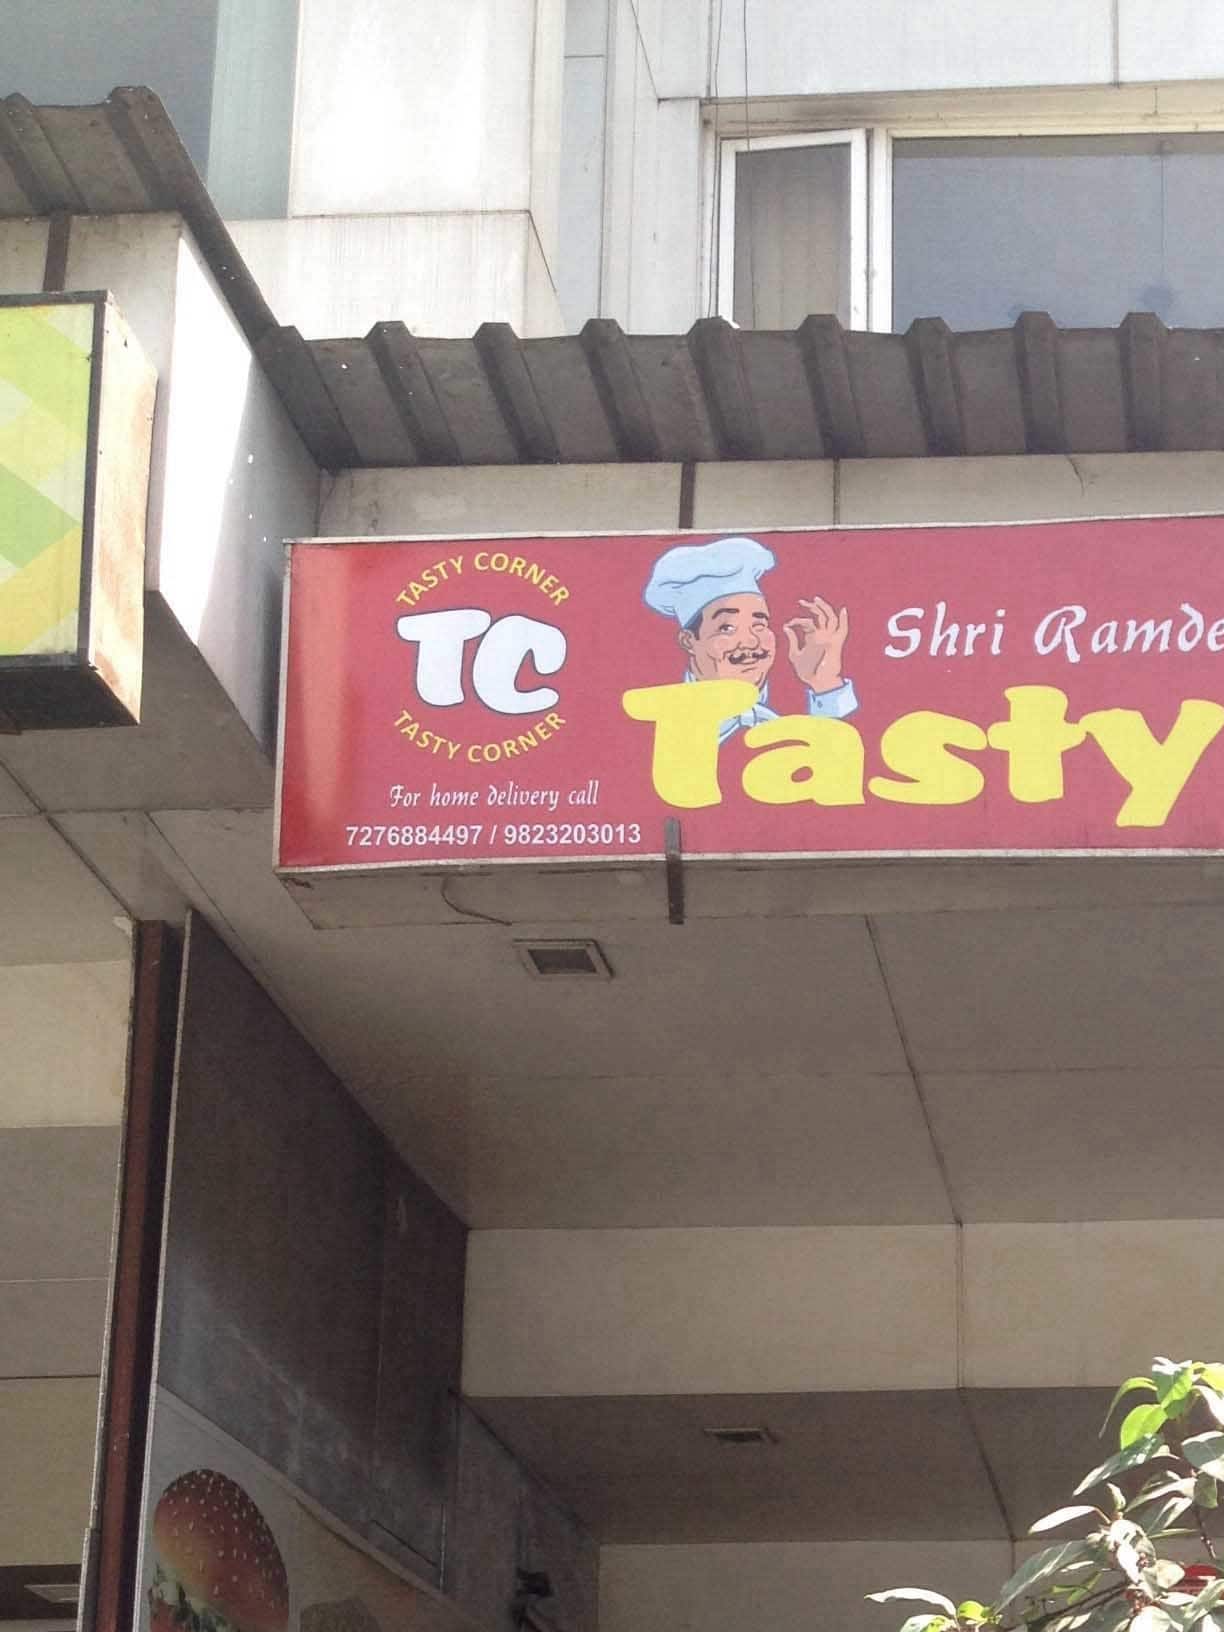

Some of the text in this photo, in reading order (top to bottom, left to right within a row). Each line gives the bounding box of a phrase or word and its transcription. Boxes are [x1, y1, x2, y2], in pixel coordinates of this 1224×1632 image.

[396, 552, 569, 607] TASTY CORNER
[884, 601, 1004, 658] Shri
[396, 608, 567, 715] TC
[394, 710, 566, 762] TASTY CORNER
[390, 780, 599, 811] For home delivery call
[346, 825, 483, 845] 7276884497
[503, 823, 641, 845] 9823203013
